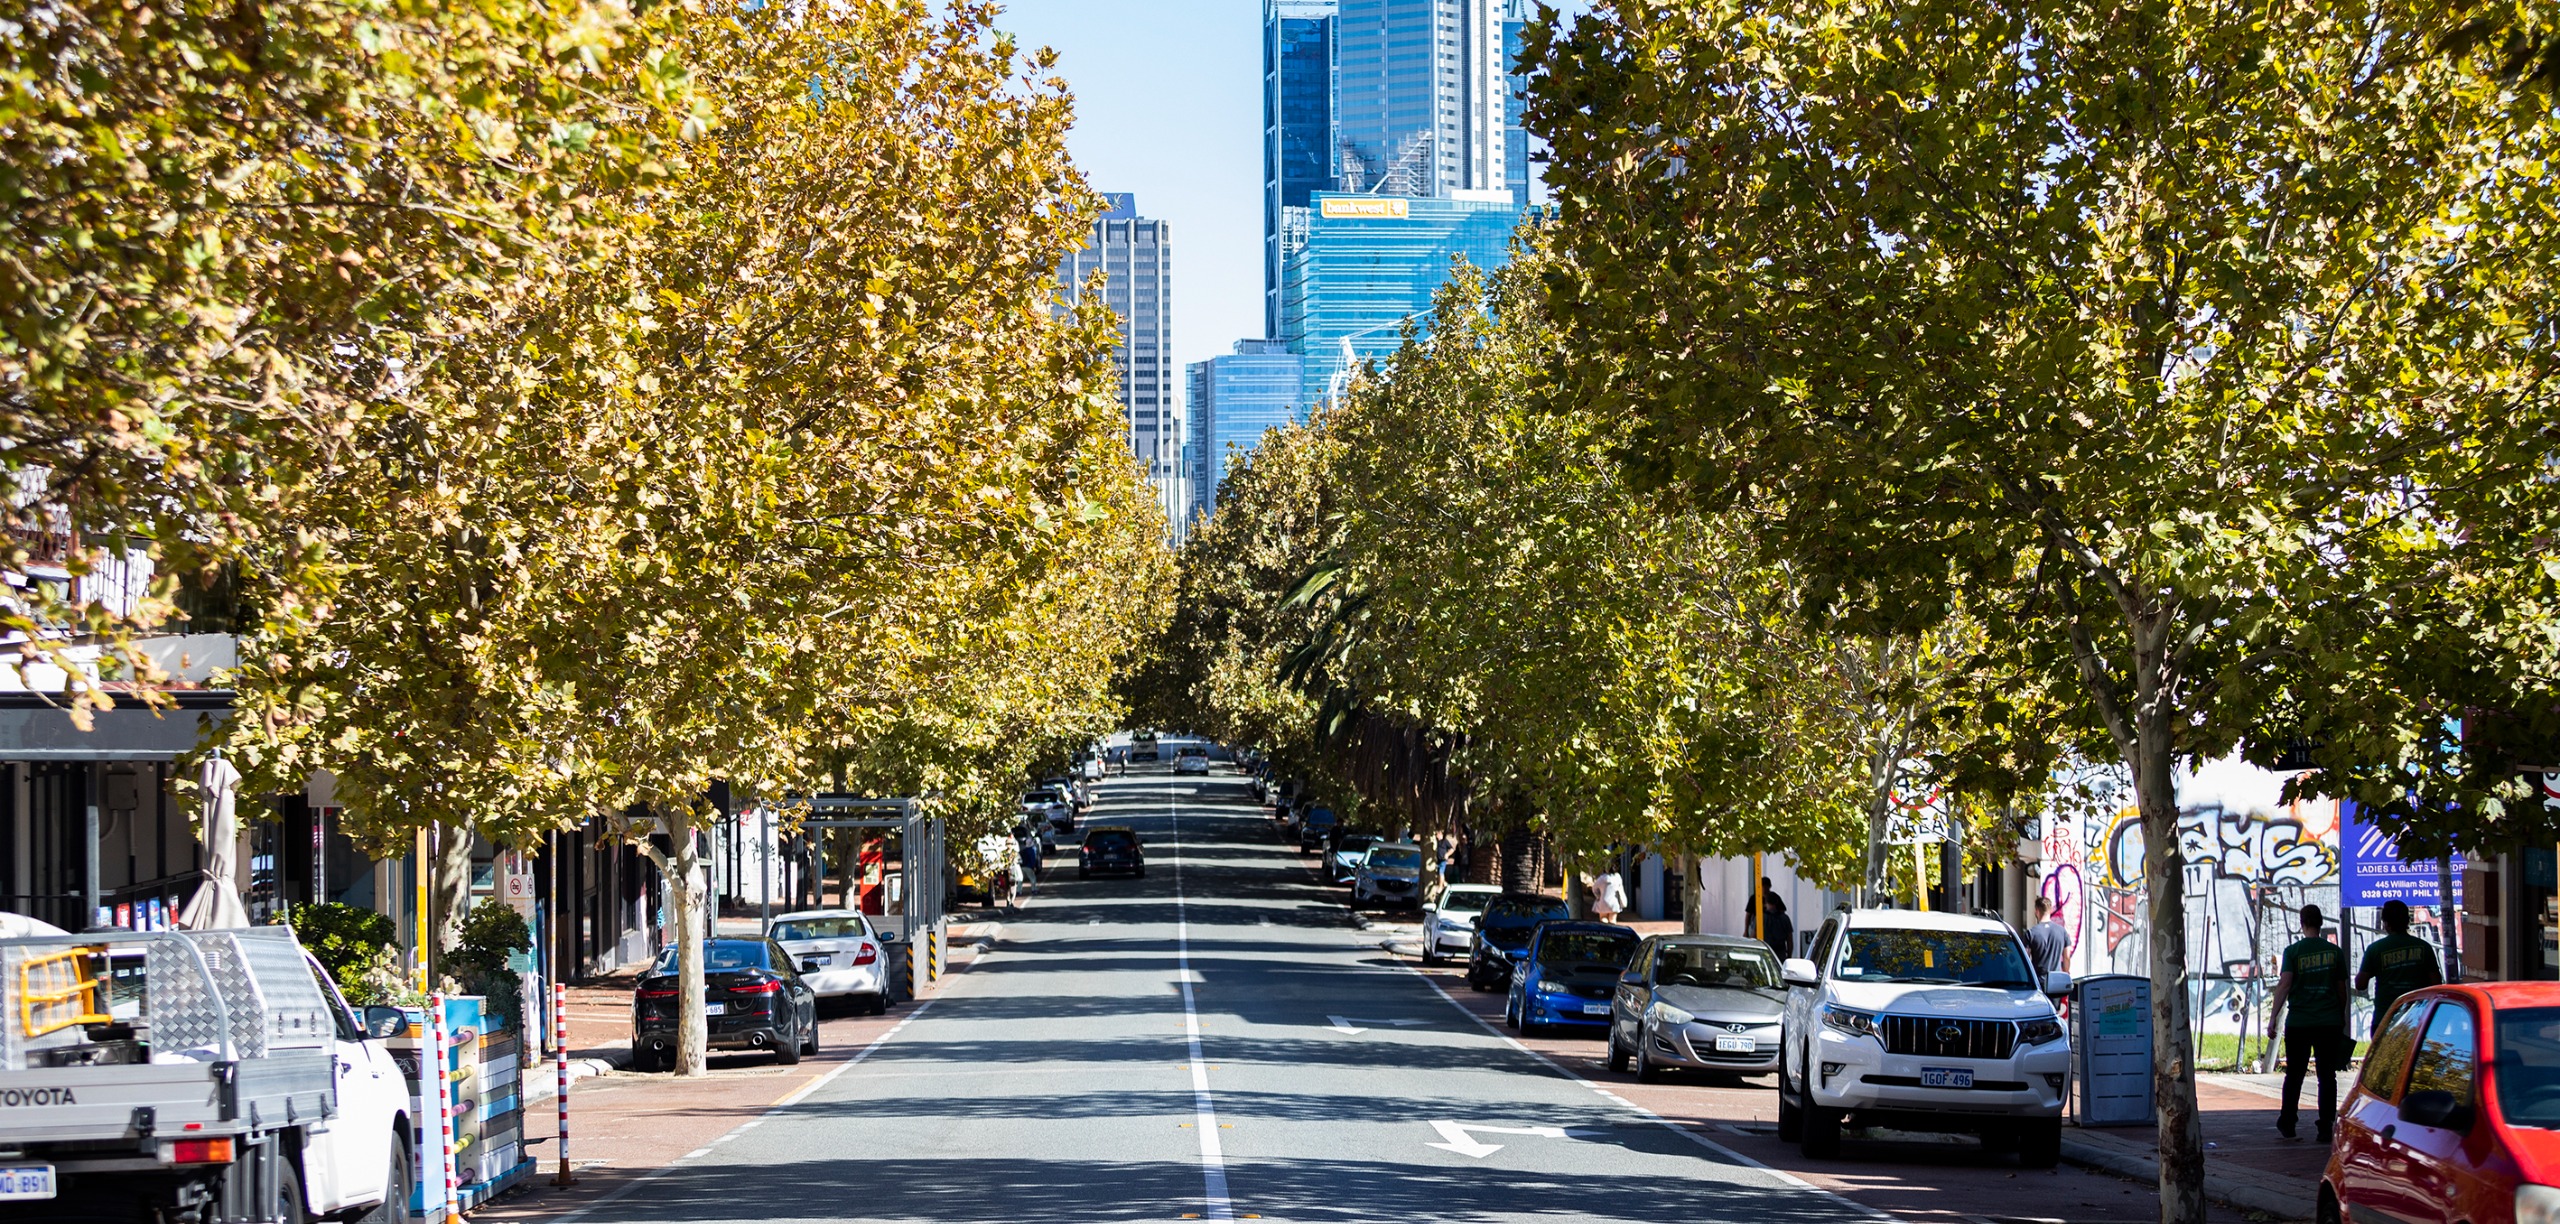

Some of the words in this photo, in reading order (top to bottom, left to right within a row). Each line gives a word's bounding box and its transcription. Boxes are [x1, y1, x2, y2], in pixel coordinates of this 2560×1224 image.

[1325, 201, 1385, 214] bankwest
[1892, 817, 1944, 834] AREA
[2357, 864, 2389, 873] LADIES
[2391, 865, 2396, 873] &
[2399, 864, 2429, 873] GENTS
[2390, 880, 2417, 888] William
[2418, 880, 2439, 888] Stree
[2361, 890, 2381, 898] 9328
[2382, 890, 2402, 898] 6570
[2412, 889, 2432, 897] PHIL
